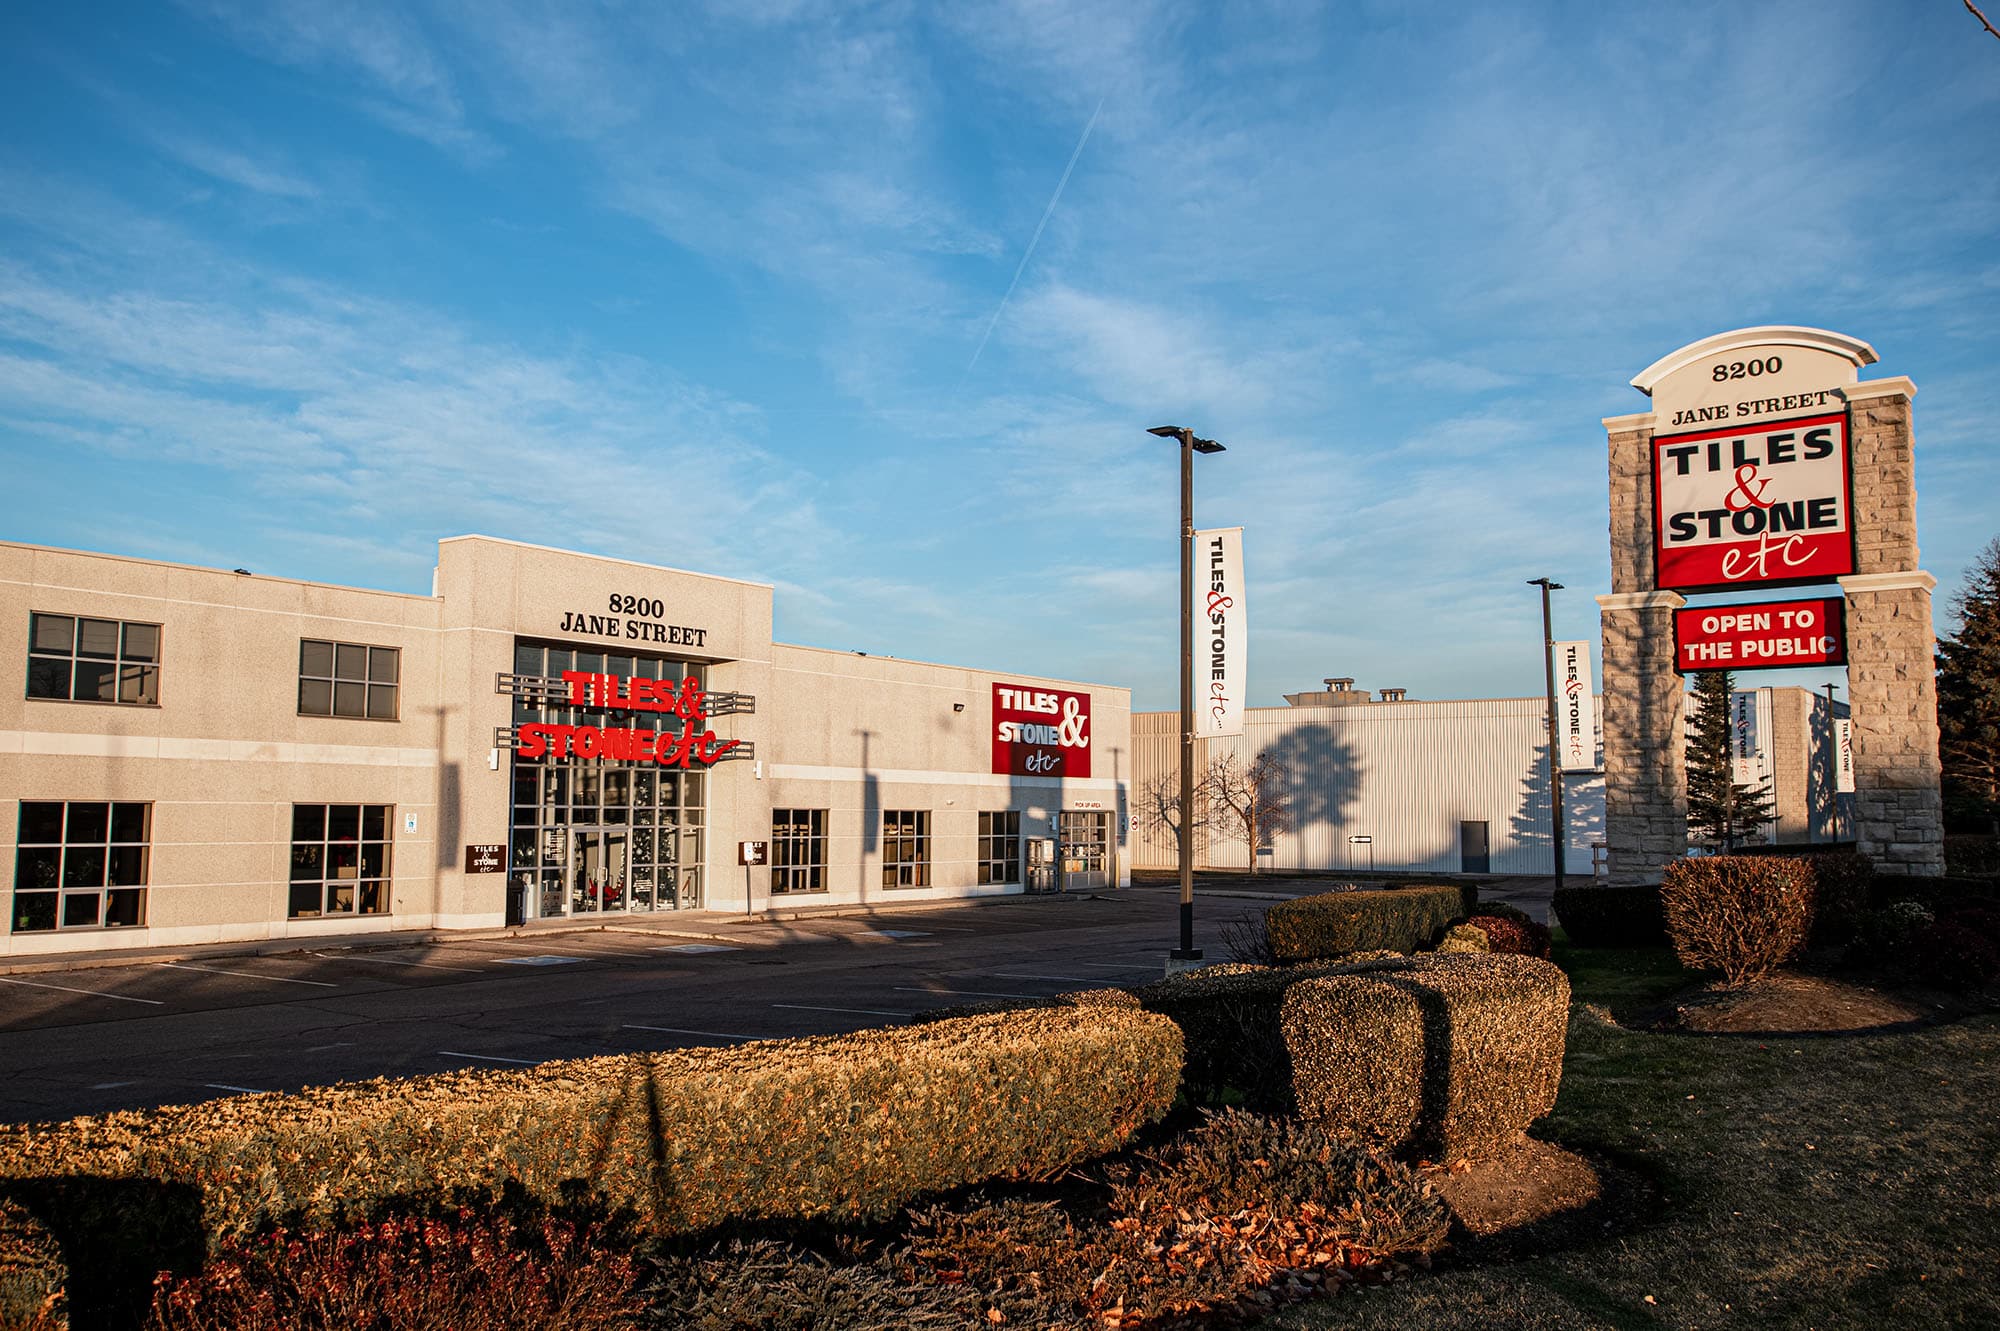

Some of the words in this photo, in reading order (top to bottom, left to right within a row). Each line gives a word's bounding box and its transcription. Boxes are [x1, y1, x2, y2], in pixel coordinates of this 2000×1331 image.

[1712, 356, 1783, 382] 8200
[1671, 404, 1729, 426] JANE
[1736, 390, 1830, 417] STREET
[1666, 428, 1834, 476] TILES
[1723, 463, 1777, 512] &
[1668, 497, 1838, 542] STONE
[1211, 537, 1225, 593] TILES
[1721, 531, 1818, 579] etc
[608, 593, 665, 619] 8200
[1207, 591, 1233, 618] &
[1702, 612, 1771, 634] OPEN
[1779, 610, 1815, 629] TO
[560, 612, 620, 638] JANE
[626, 620, 707, 648] STREET
[1211, 613, 1225, 681] STONE
[1684, 642, 1733, 661] THE
[1742, 635, 1836, 659] PUBLIC
[1567, 646, 1578, 681] TILES
[562, 670, 675, 713] TILES
[674, 675, 708, 721] &
[1565, 678, 1584, 695] &
[998, 688, 1059, 715] TILES
[1058, 696, 1089, 748] &
[1569, 693, 1580, 735] STONE
[518, 722, 655, 761] STONE
[654, 720, 741, 769] etc
[998, 720, 1059, 746] STONE
[473, 858, 499, 866] STONE
[474, 845, 499, 853] TILES
